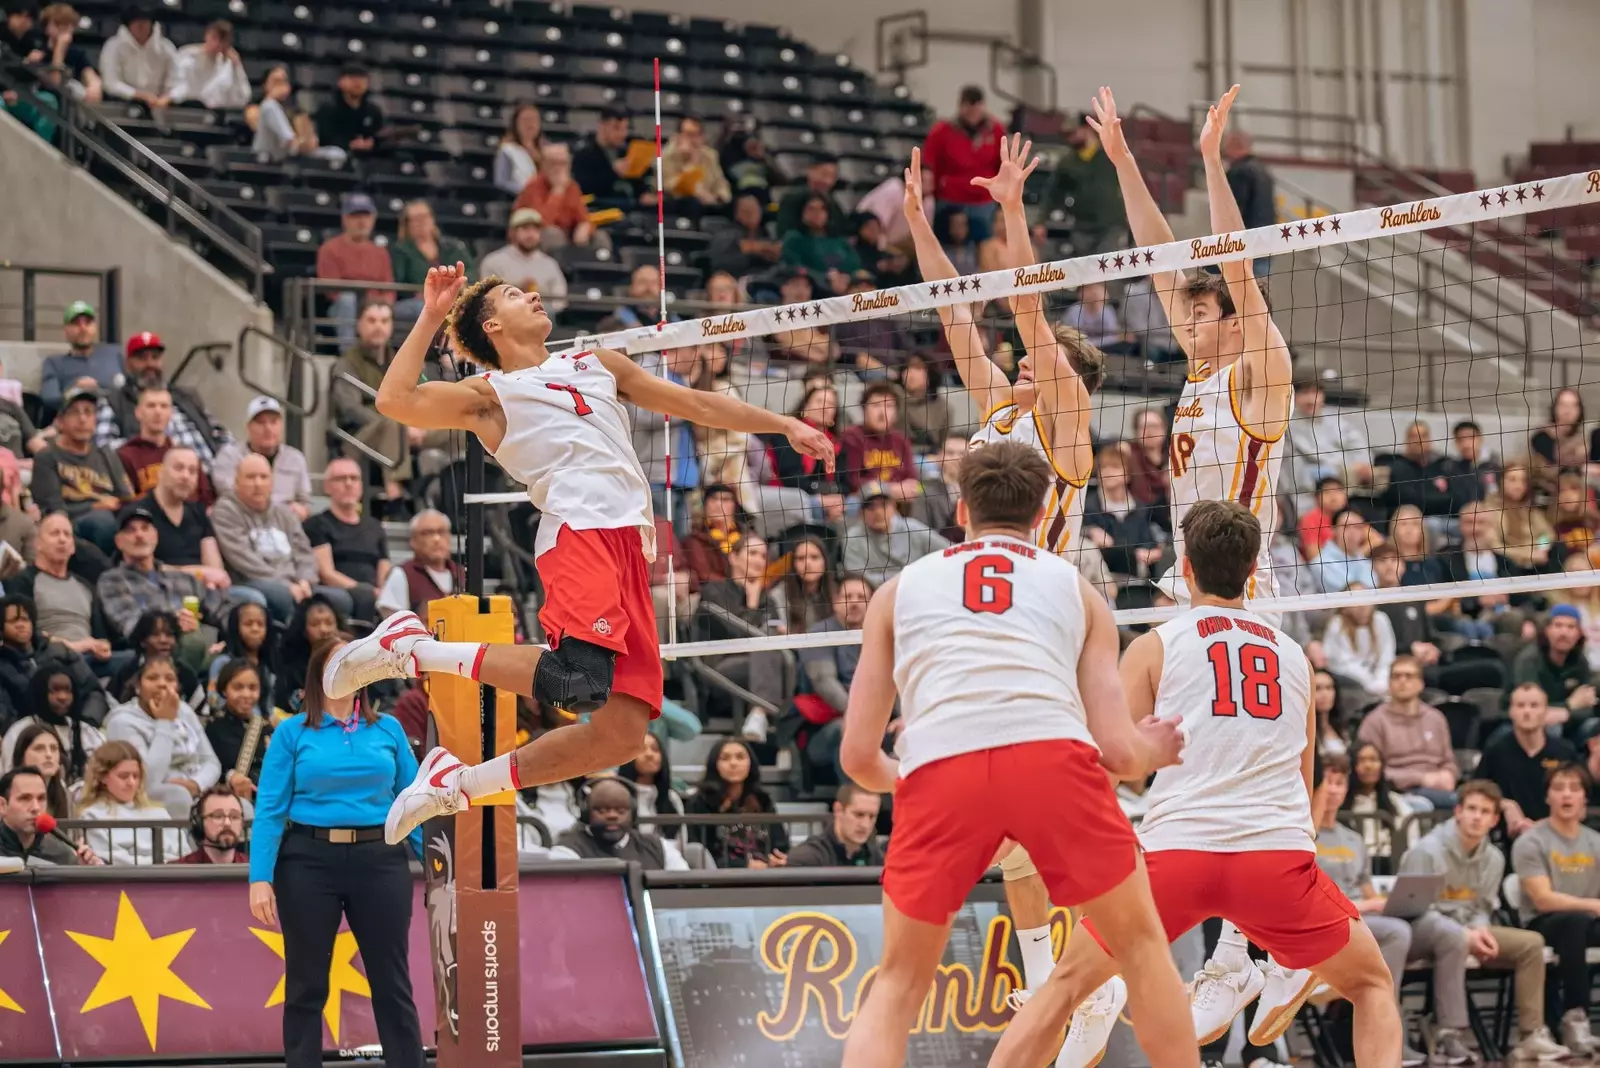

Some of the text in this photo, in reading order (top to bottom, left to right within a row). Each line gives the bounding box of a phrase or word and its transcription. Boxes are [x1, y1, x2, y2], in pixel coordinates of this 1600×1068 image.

[1380, 201, 1441, 229] Ramblers
[1190, 234, 1246, 260] Ramblers
[1013, 262, 1066, 288] Ramblers
[701, 314, 747, 337] Ramblers
[963, 554, 1014, 615] 6
[1196, 615, 1279, 647] OHIO STATE
[1207, 641, 1282, 720] 18
[481, 920, 499, 978] sports
